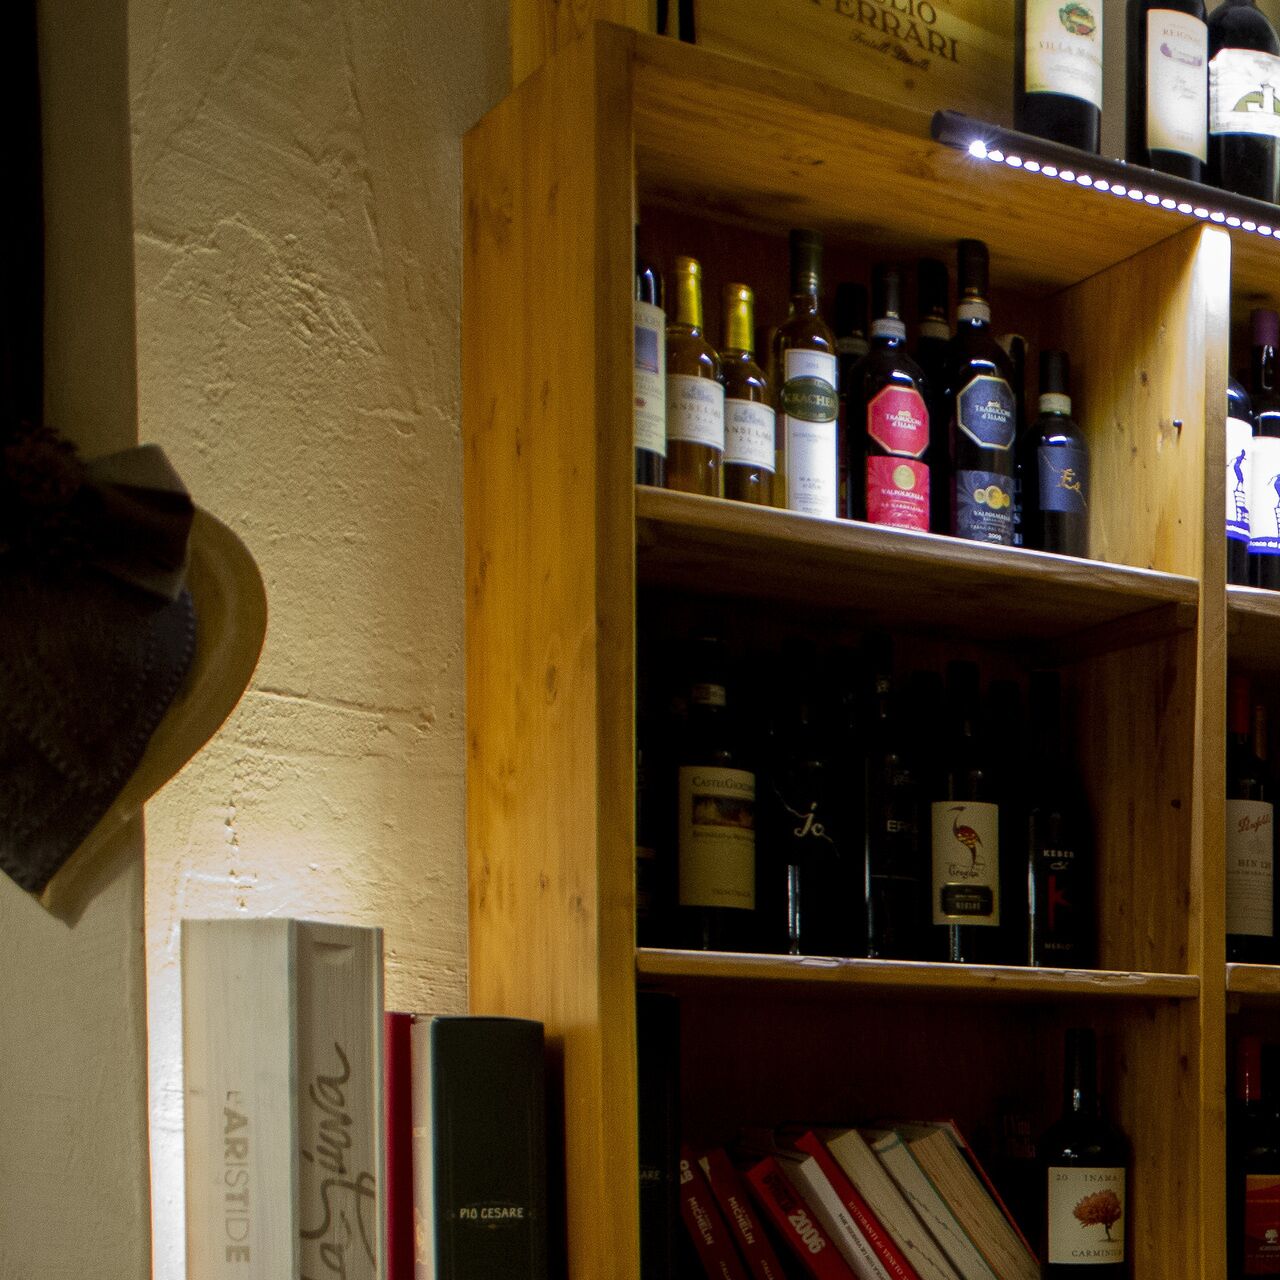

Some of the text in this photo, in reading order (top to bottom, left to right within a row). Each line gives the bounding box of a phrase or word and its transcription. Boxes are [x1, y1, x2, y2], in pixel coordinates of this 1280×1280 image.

[812, 0, 959, 63] ERRARI
[459, 1207, 524, 1219] PIO CESARE
[687, 1196, 714, 1247] MICHELIN
[728, 1196, 756, 1246] MICHELIN
[788, 1208, 827, 1255] 2006
[847, 1199, 879, 1242] RISTORANTI
